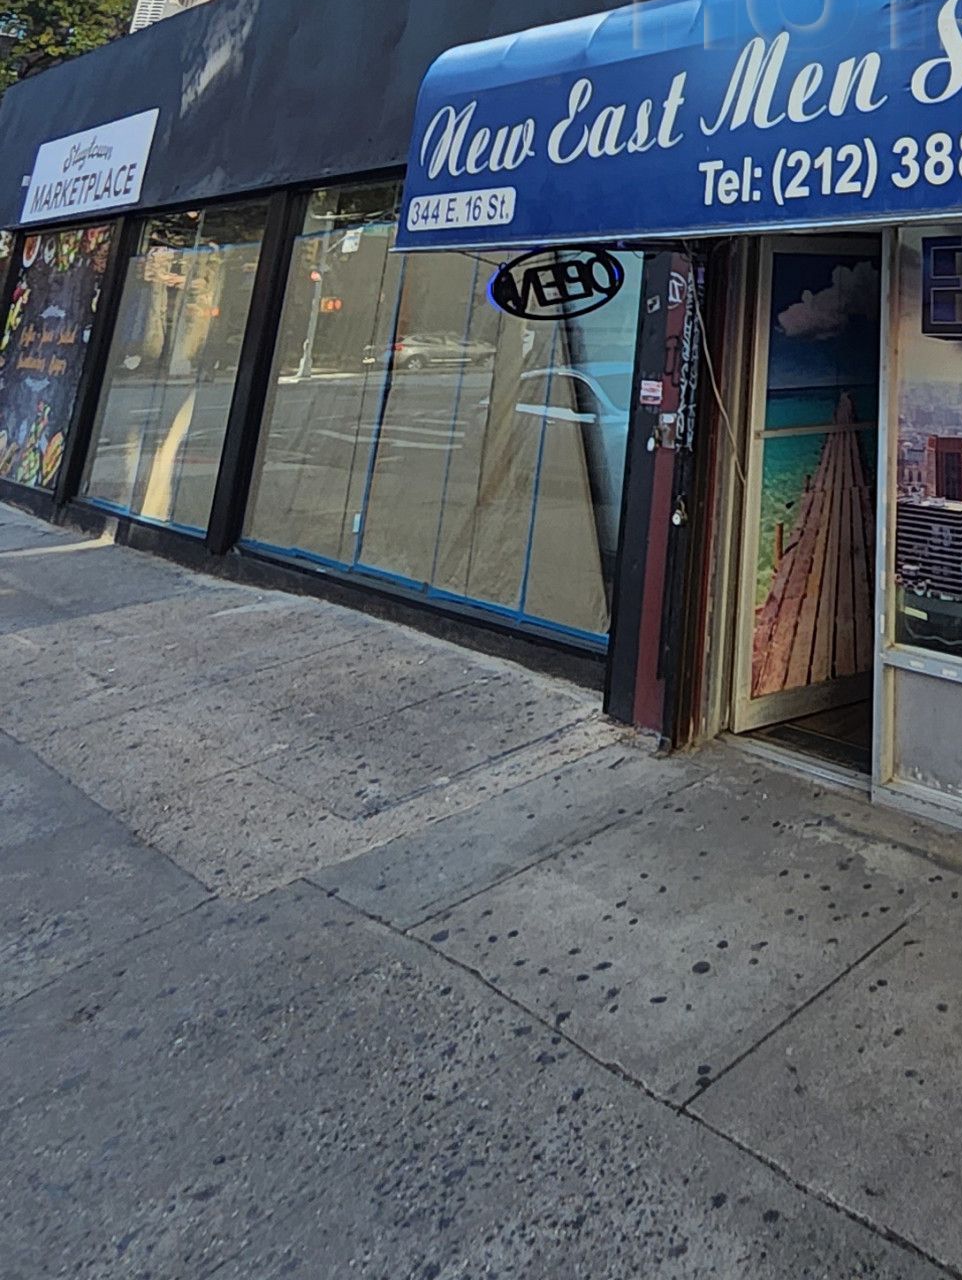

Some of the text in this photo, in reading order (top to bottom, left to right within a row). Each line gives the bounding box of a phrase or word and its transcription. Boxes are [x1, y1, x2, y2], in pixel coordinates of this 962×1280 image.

[420, 100, 535, 179] New
[548, 71, 687, 164] East
[700, 31, 888, 136] Men
[30, 163, 137, 214] MARKETPLACE
[699, 157, 762, 206] Tel:
[772, 138, 878, 205] (212)
[411, 192, 509, 226] 344 E. 16 St.
